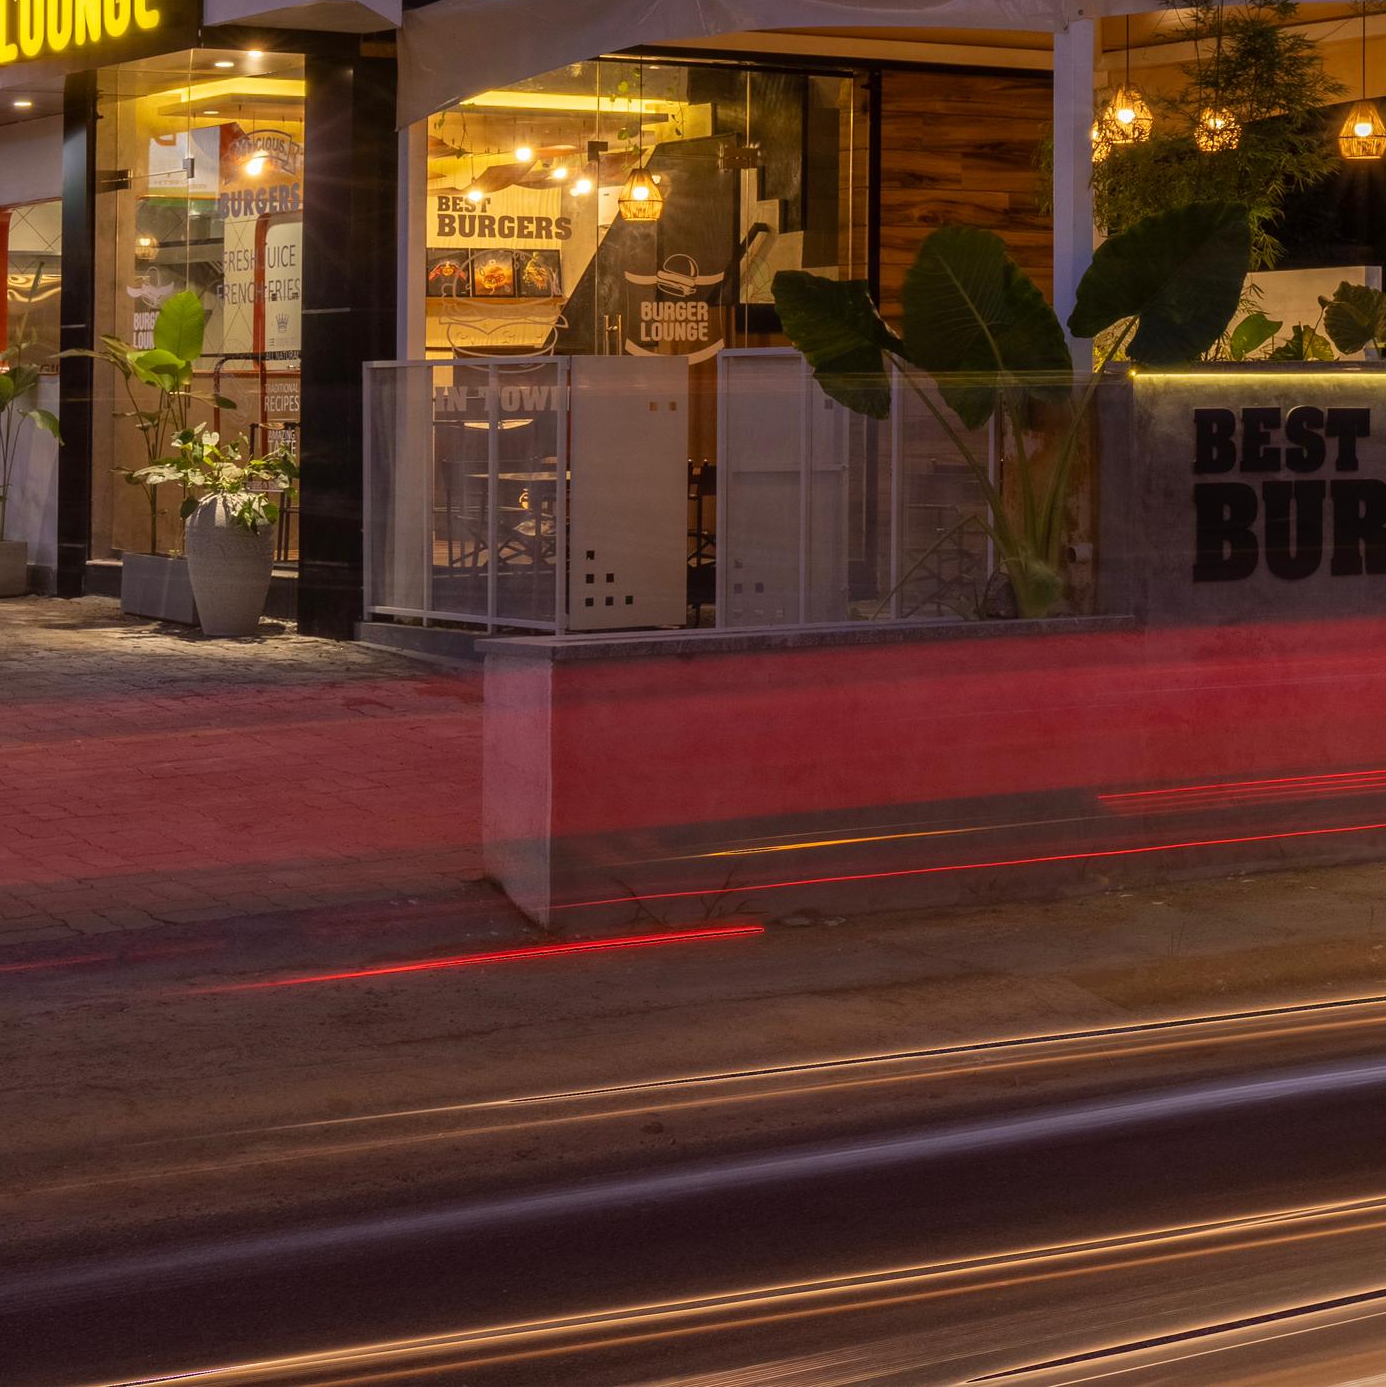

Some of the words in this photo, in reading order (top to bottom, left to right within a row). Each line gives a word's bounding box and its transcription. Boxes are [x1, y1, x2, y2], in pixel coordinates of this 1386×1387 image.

[218, 181, 302, 219] BURGERS
[437, 196, 492, 214] BEST
[436, 213, 573, 241] BURGERS
[222, 248, 258, 274] FRESH
[260, 244, 297, 270] UICE
[268, 277, 301, 303] FRIES
[132, 311, 161, 332] BURG
[640, 300, 709, 322] BURGER
[132, 331, 156, 351] LOU
[640, 321, 709, 342] LOUNGE
[265, 383, 299, 393] TRADITIONAL
[264, 395, 300, 413] RECIPES
[434, 386, 468, 412] IN
[268, 429, 295, 442] AMAZING
[1192, 406, 1371, 474] BEST
